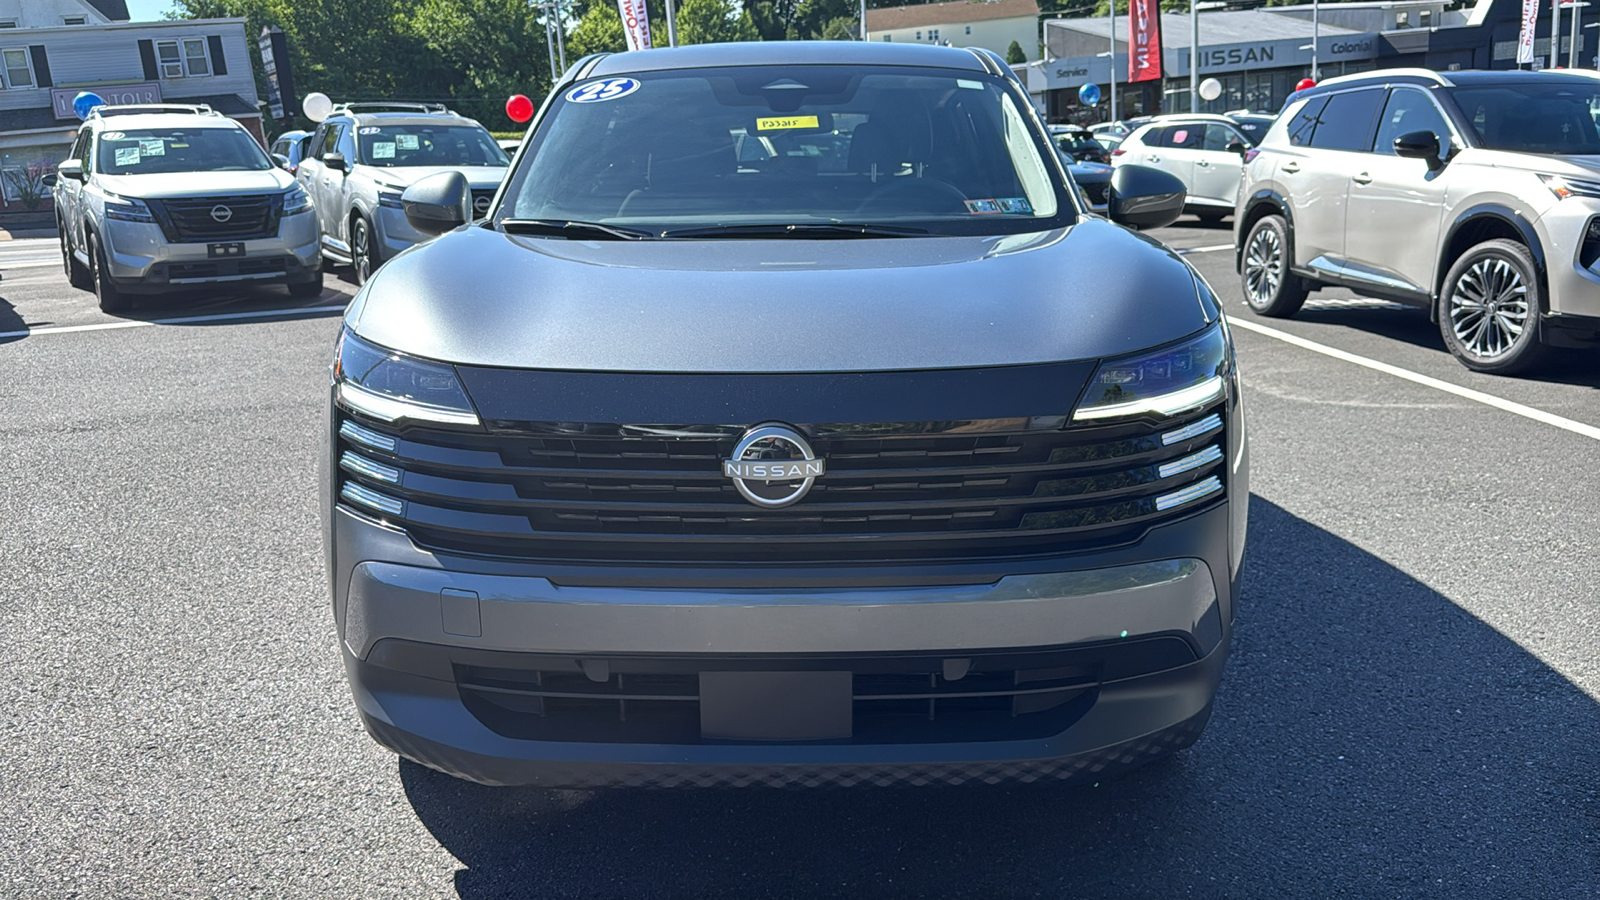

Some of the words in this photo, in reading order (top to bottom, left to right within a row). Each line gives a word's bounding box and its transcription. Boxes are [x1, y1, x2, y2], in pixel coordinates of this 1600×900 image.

[1331, 41, 1372, 54] Colonial
[1056, 67, 1088, 78] Service
[574, 79, 629, 101] 25
[727, 462, 820, 477] NISSAN
